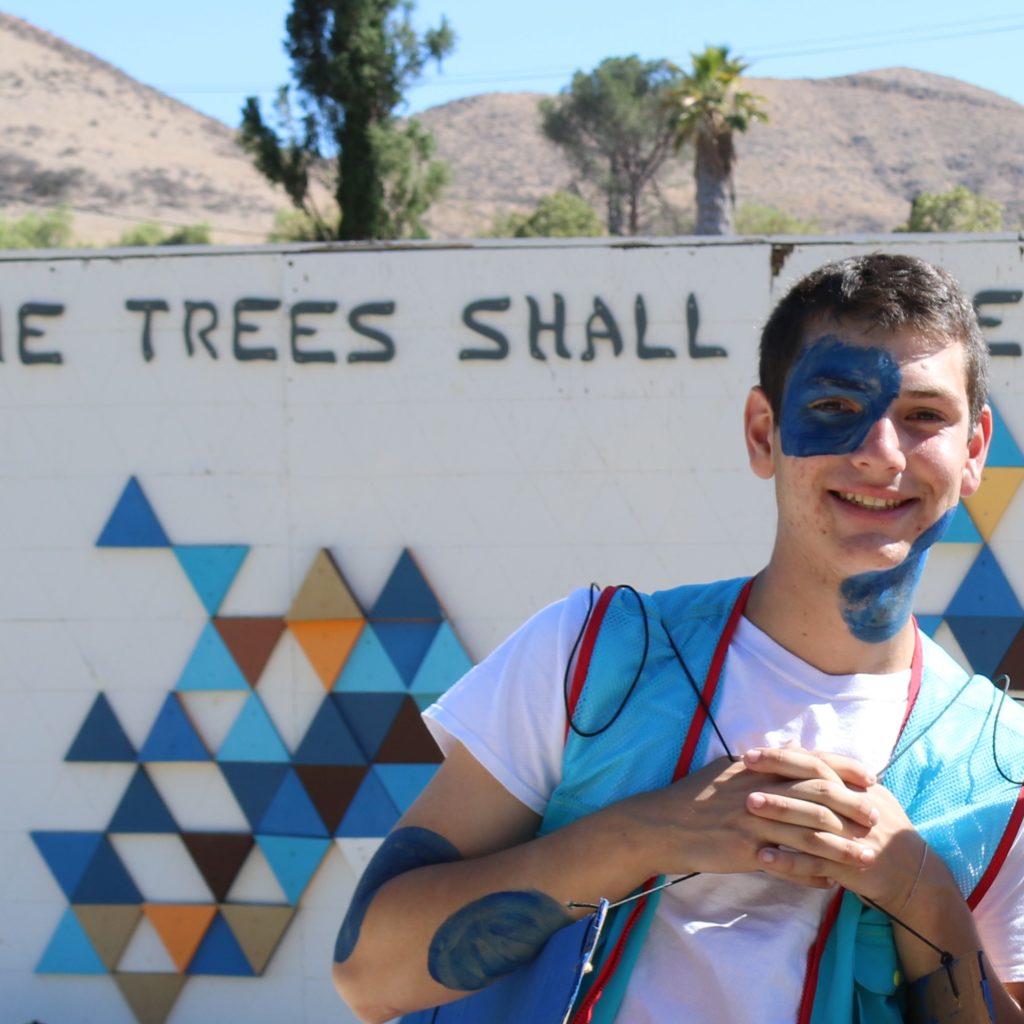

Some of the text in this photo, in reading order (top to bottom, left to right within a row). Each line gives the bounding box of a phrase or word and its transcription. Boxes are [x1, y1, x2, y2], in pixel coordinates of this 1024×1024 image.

[0, 302, 66, 366] E
[126, 298, 396, 364] TREES
[459, 293, 729, 362] SHALL
